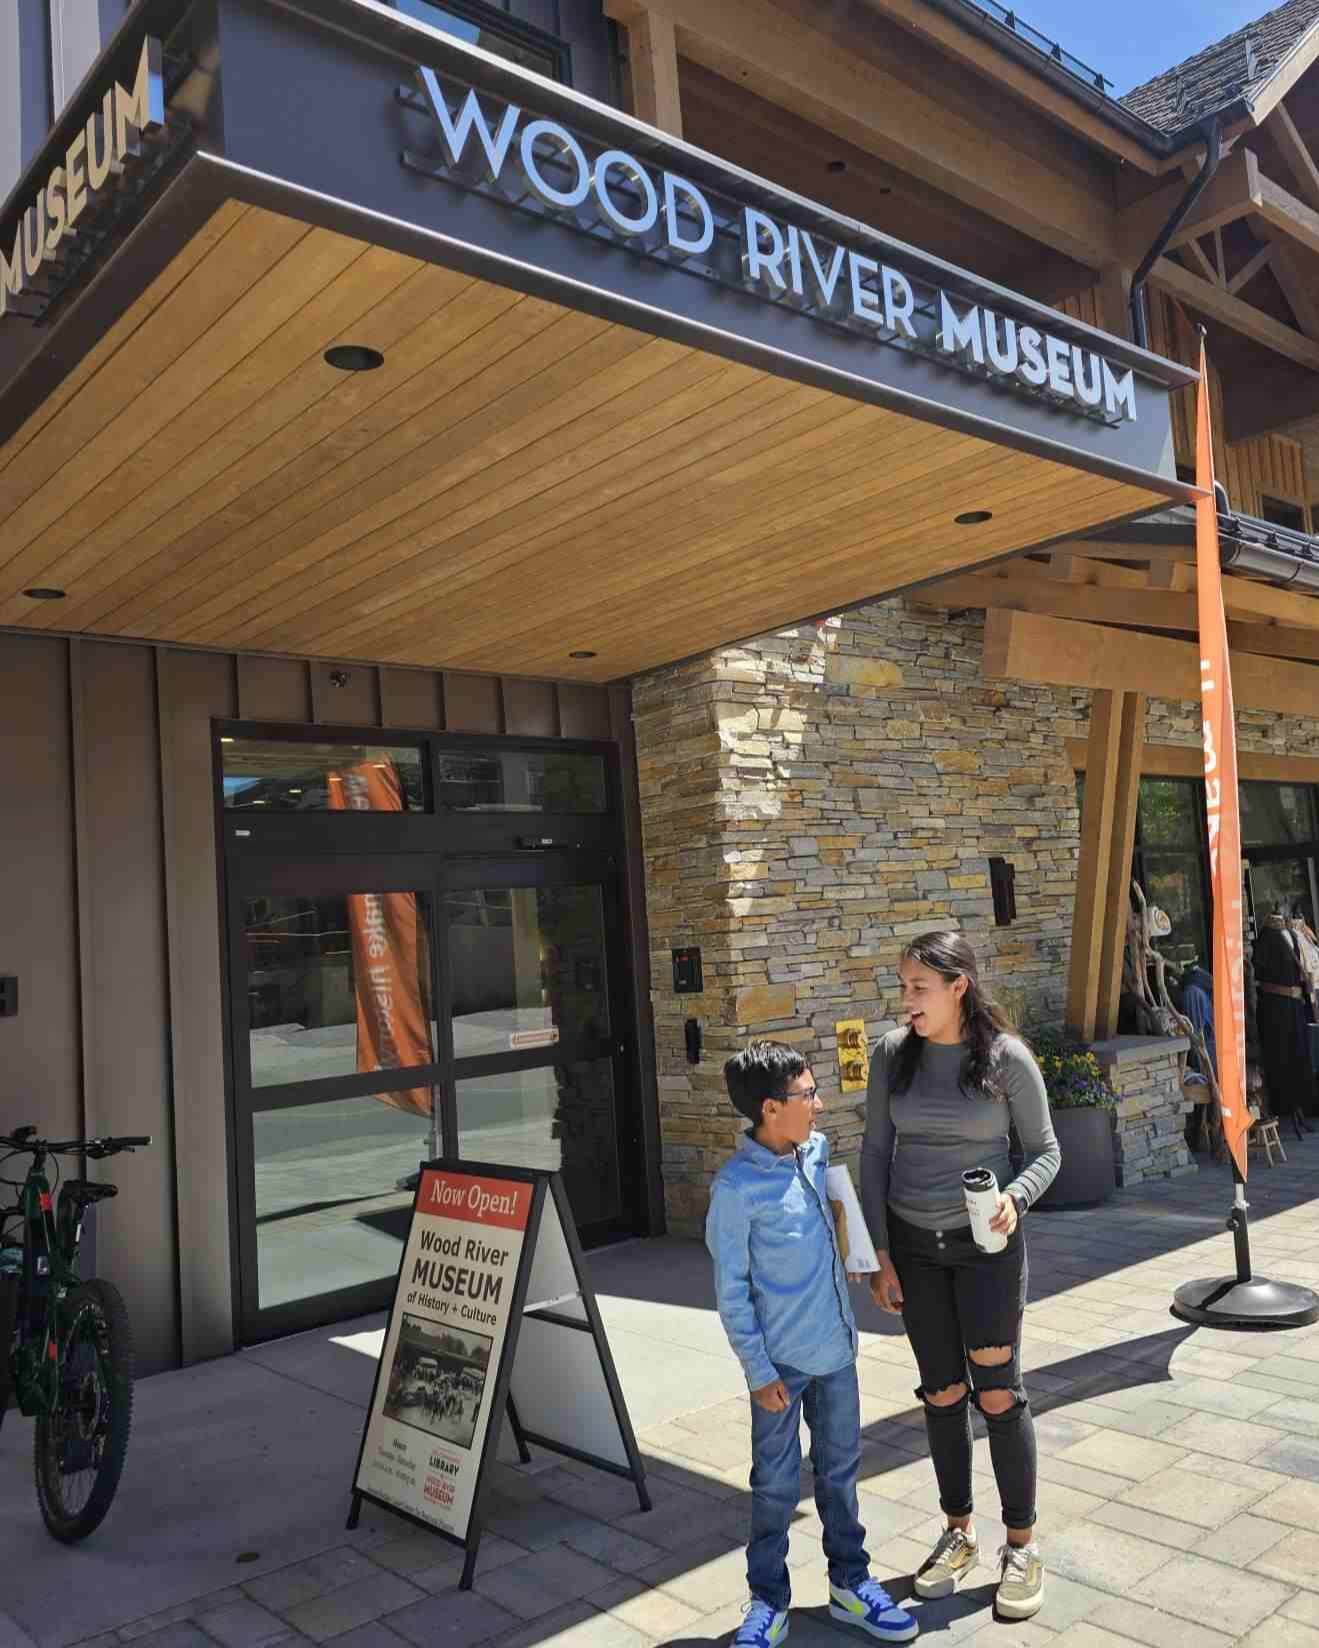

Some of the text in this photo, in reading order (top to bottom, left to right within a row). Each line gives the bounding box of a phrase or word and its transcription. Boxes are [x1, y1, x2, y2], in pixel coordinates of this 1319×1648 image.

[0, 34, 152, 317] MUSEUM
[419, 65, 1137, 422] WOOD RIVER MUSEUM
[431, 1179, 518, 1217] Now Open!
[420, 1229, 509, 1266] Wood River
[411, 1258, 503, 1305] MUSEUM
[407, 1291, 417, 1304] of
[417, 1293, 450, 1315] History
[460, 1304, 497, 1325] Culture
[429, 1455, 460, 1477] LIBRARY
